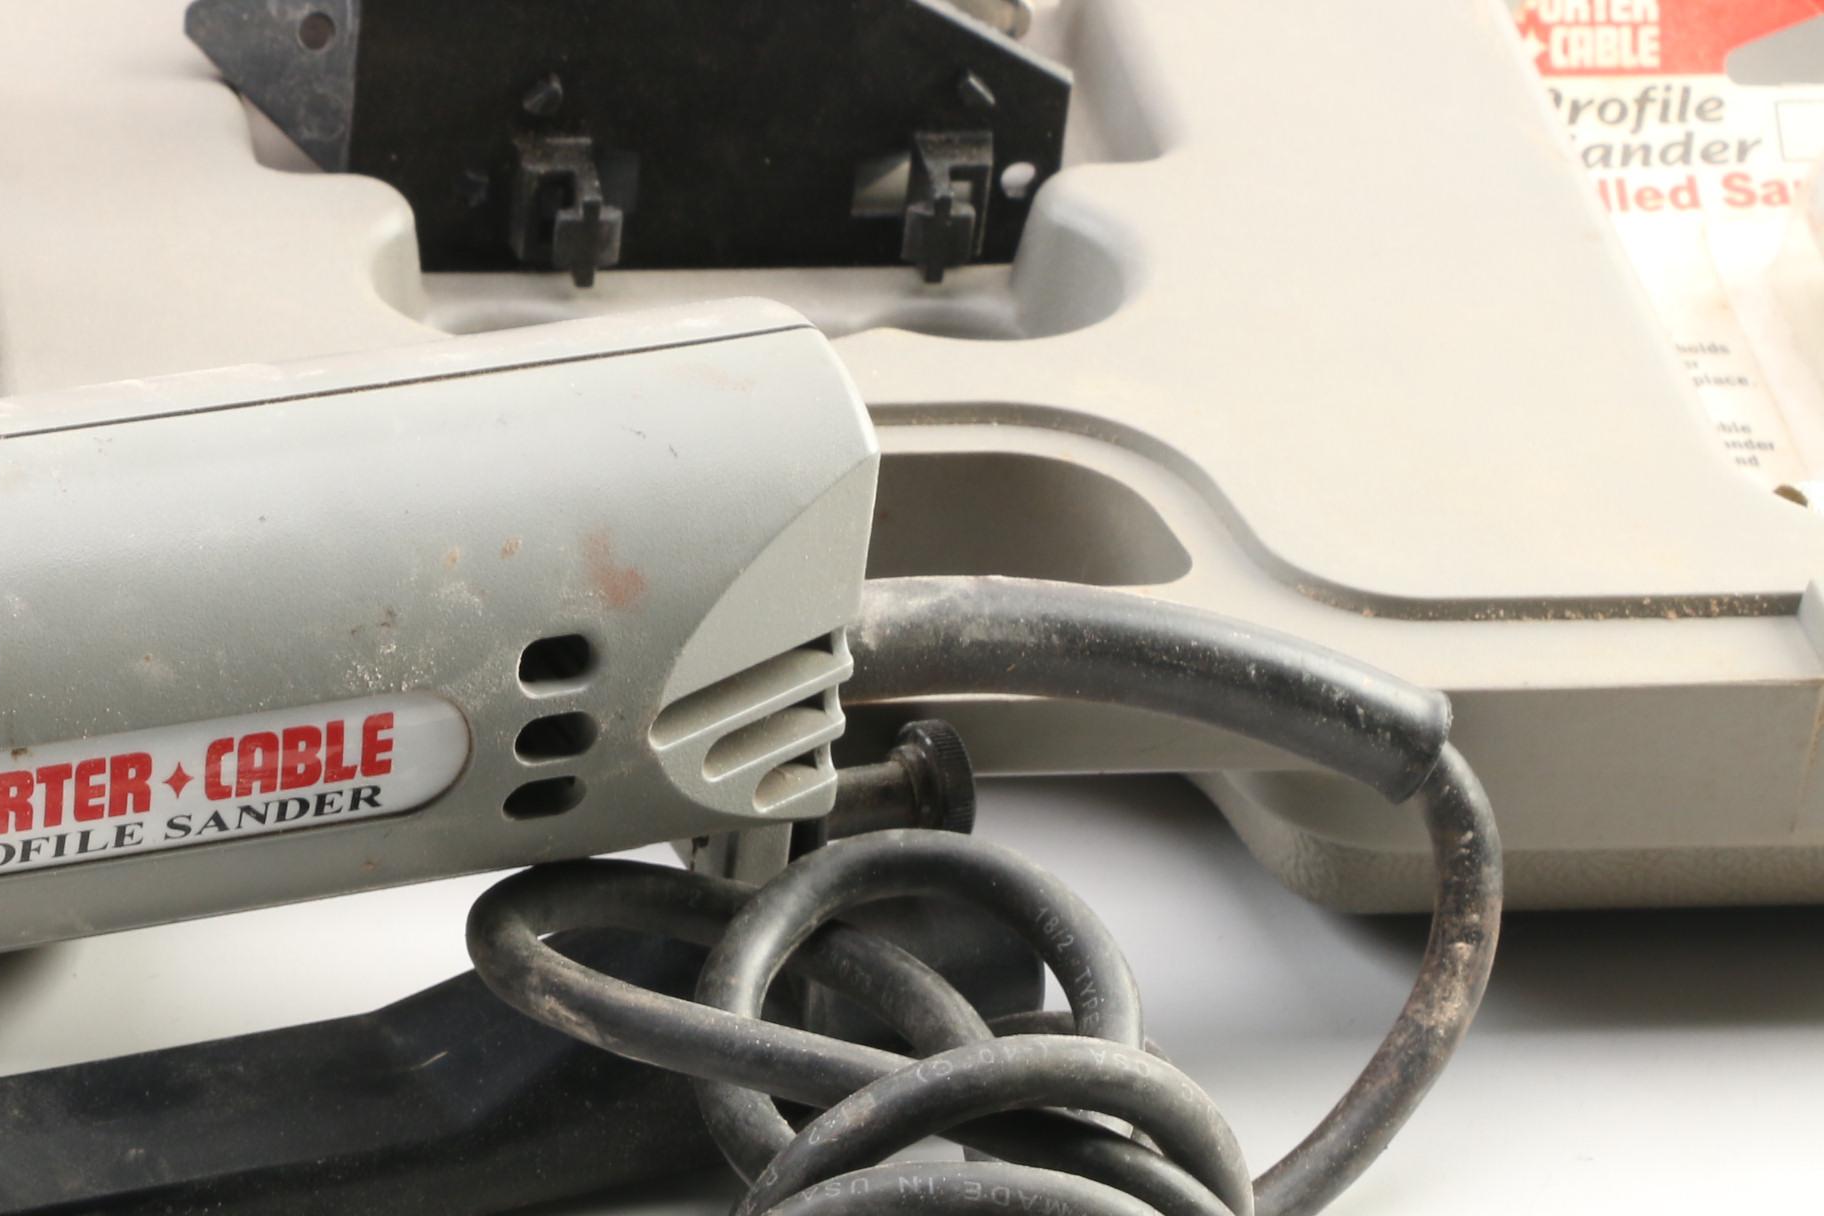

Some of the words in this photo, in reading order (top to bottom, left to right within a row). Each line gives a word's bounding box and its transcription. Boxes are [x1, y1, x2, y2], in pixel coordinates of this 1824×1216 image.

[1549, 25, 1660, 69] CABLE
[1569, 131, 1763, 169] ander
[1721, 172, 1805, 209] Sa
[204, 711, 394, 801] CABLE
[164, 785, 382, 841] SANDER
[1074, 966, 1102, 1033] TYPE
[800, 1175, 869, 1201] USA
[899, 1175, 936, 1196] IN
